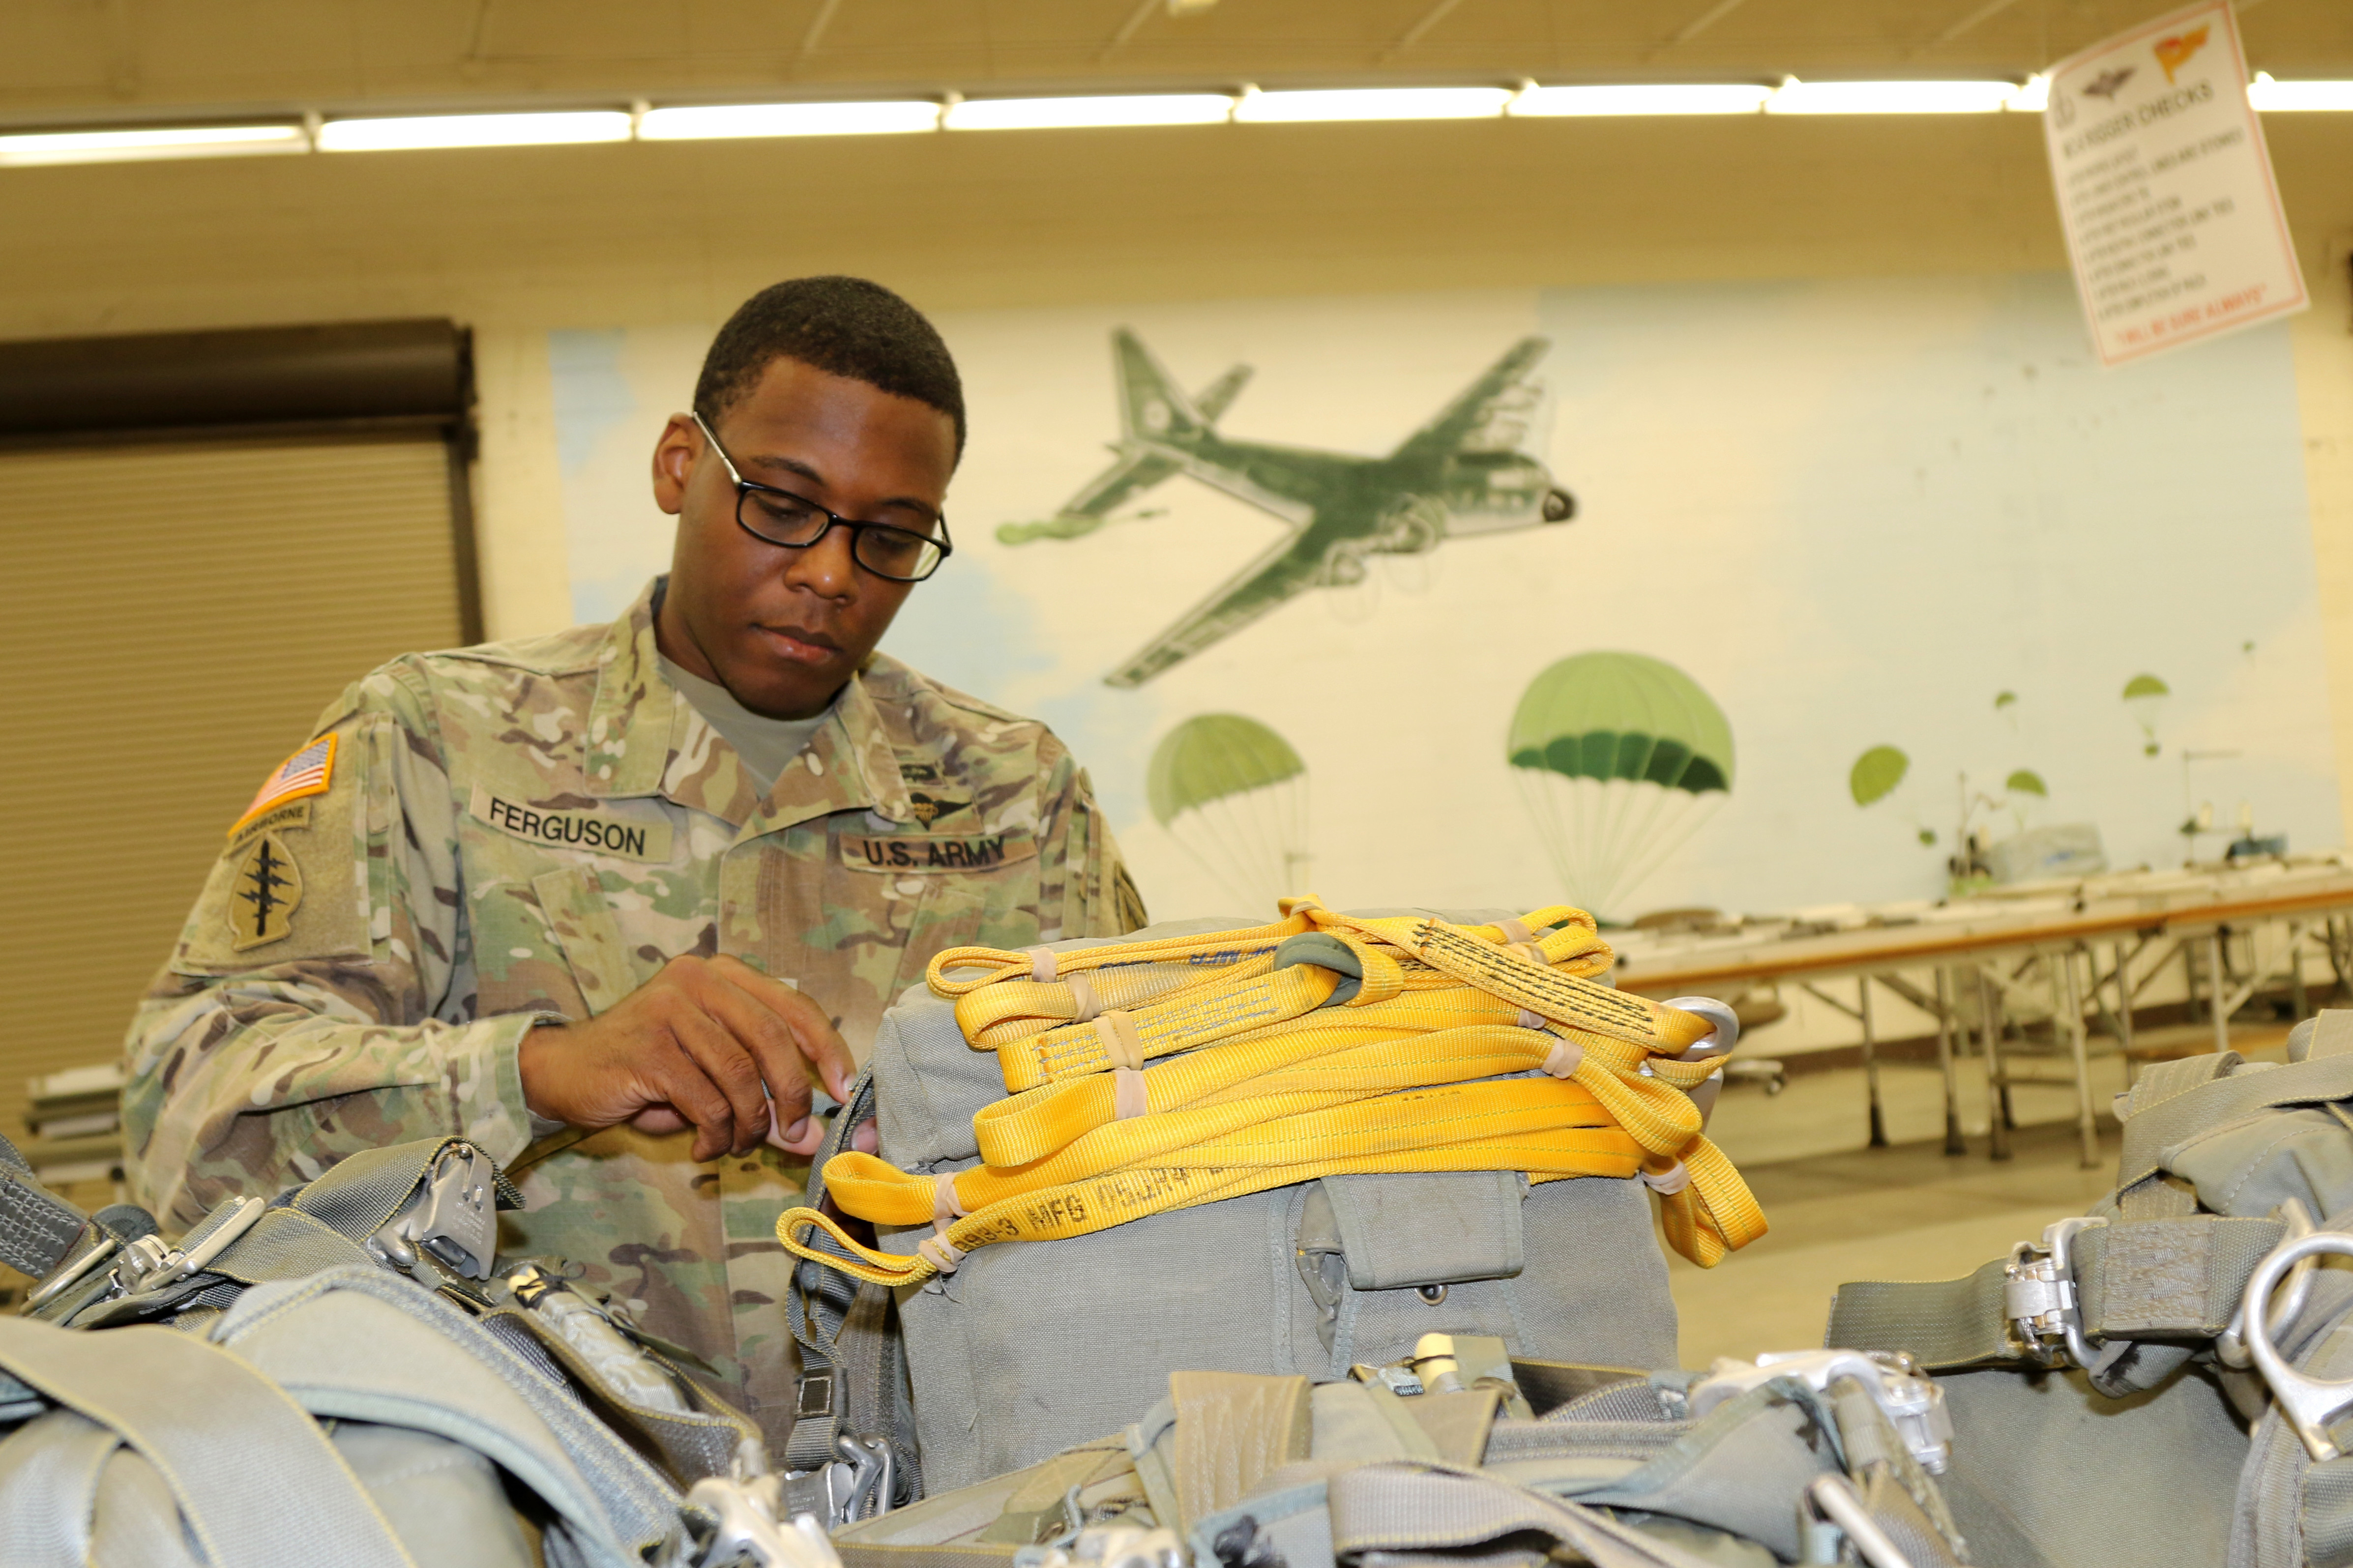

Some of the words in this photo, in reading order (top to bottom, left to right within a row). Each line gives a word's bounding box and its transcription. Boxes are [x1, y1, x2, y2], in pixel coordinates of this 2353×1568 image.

[491, 797, 646, 856] FERGUSON
[863, 840, 918, 867] U.S.
[929, 837, 1005, 867] ARMY
[1028, 1194, 1088, 1231] MFG
